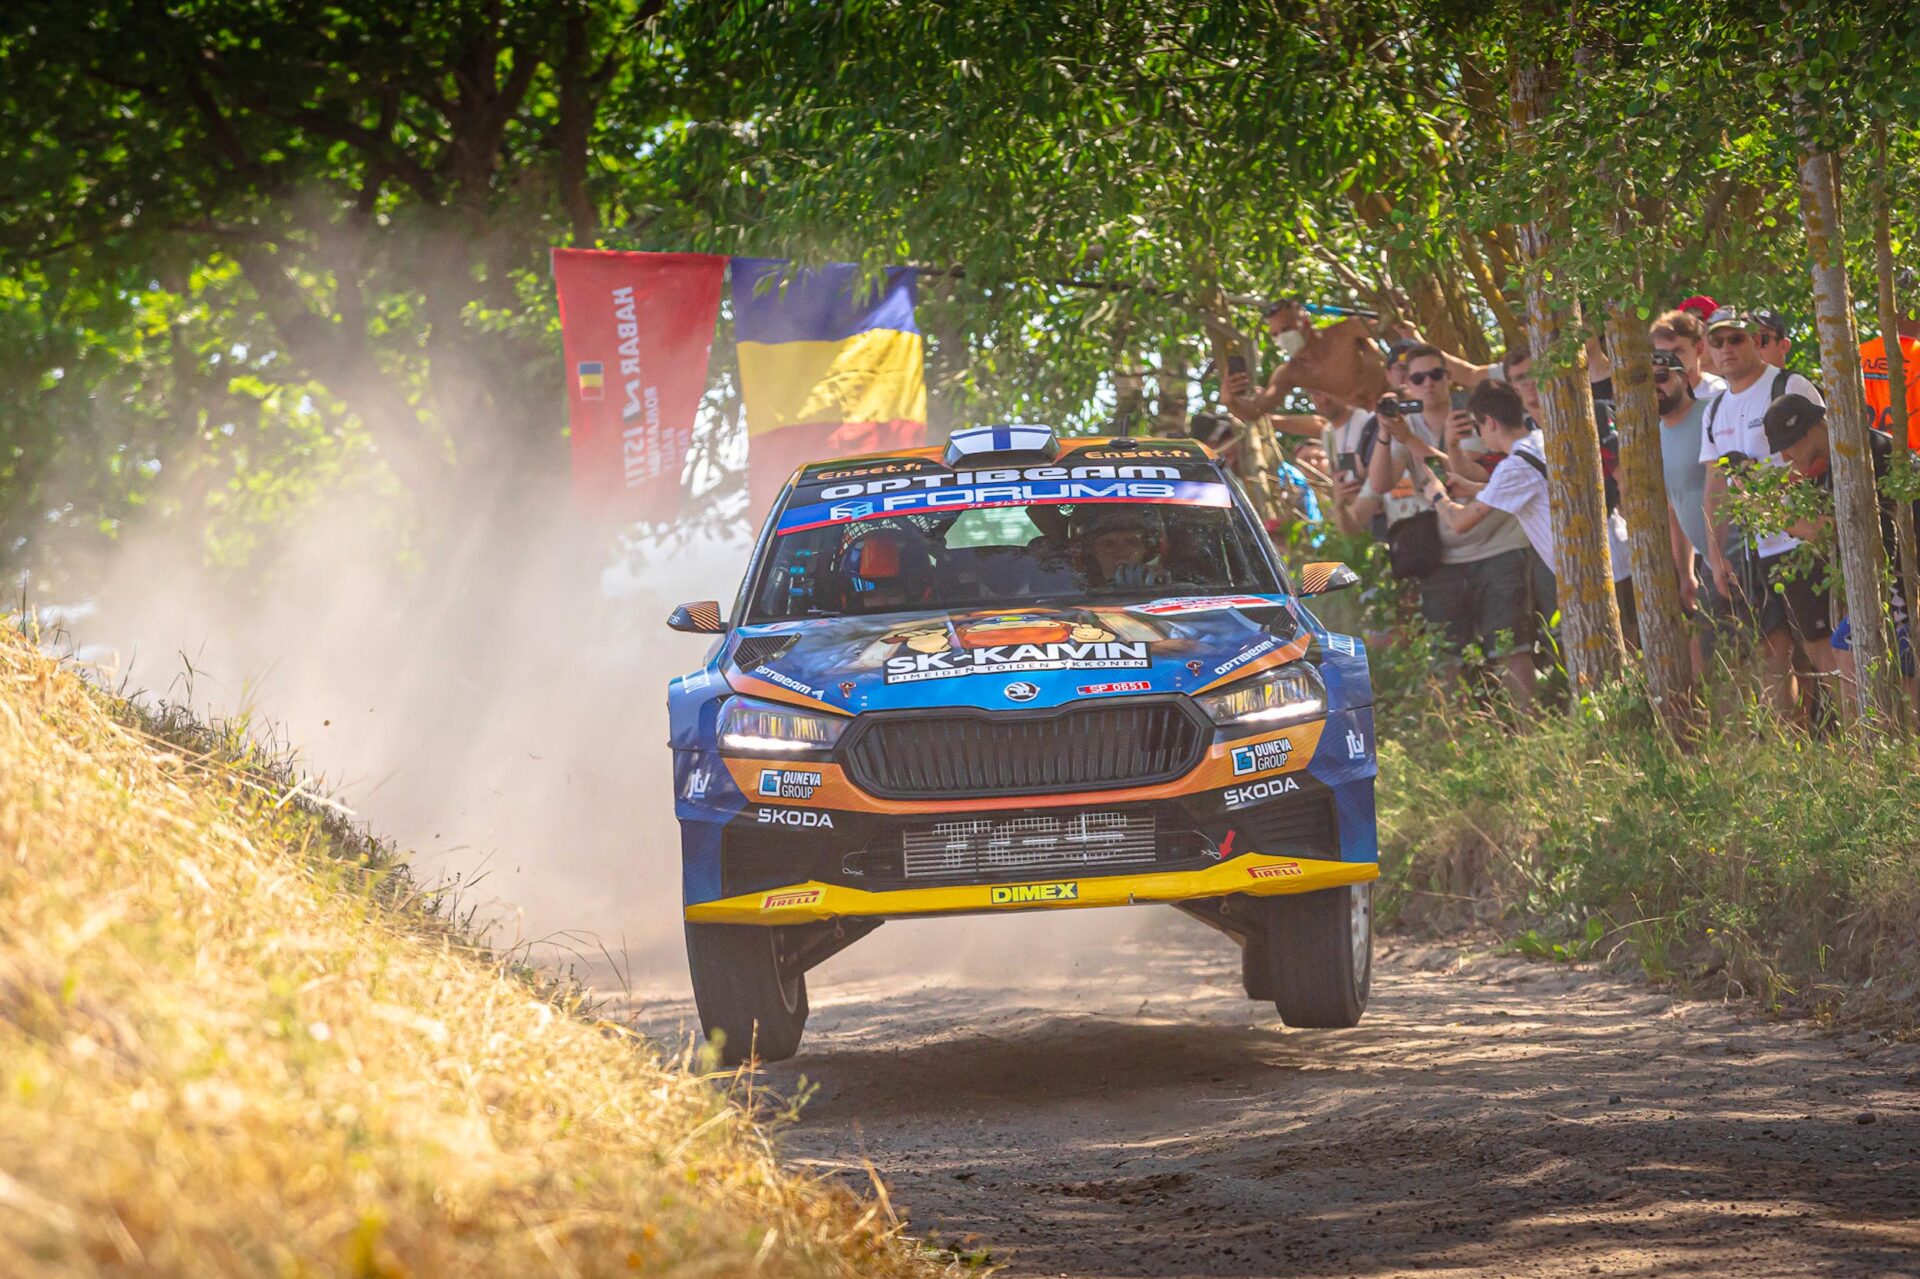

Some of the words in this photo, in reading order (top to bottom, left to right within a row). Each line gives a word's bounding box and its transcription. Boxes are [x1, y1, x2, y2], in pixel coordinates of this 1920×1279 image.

[821, 465, 1181, 499] OPTIBEAM
[883, 482, 1175, 511] FORUM8
[892, 666, 974, 682] PIMEIDEN
[986, 662, 1049, 672] TOIDEN
[1255, 739, 1293, 757] OUNEVA
[1257, 753, 1288, 771] GROUP
[783, 771, 821, 786] OUNEVA
[781, 785, 814, 799] GROUP
[1247, 862, 1303, 878] PIRELLI
[764, 890, 820, 909] PIRELLI
[992, 882, 1077, 903] DIMEX
